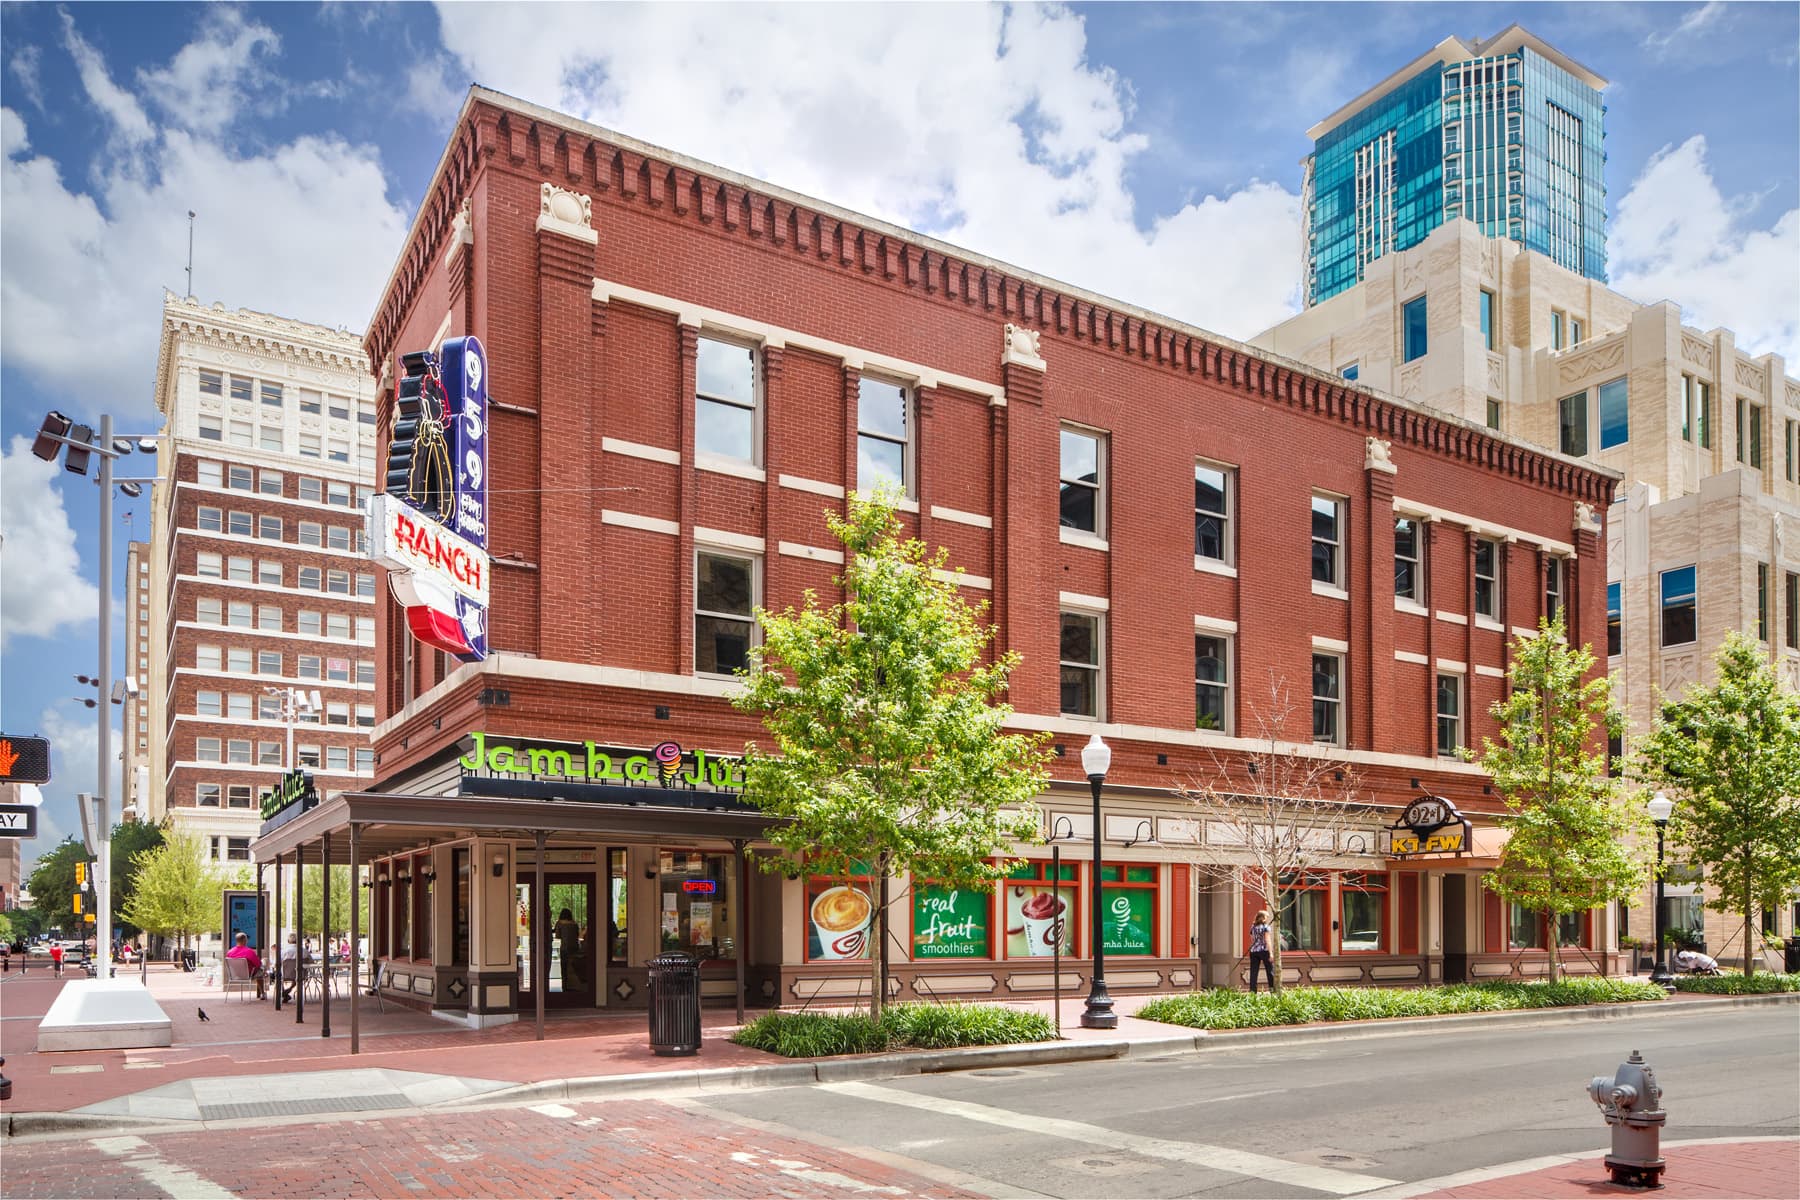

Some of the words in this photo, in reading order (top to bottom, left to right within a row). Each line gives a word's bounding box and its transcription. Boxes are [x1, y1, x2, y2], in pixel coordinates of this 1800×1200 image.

[395, 513, 480, 590] RANCH
[459, 732, 656, 781] Jamba
[683, 882, 713, 891] OPEN
[922, 890, 958, 914] real
[921, 913, 976, 944] fruit
[922, 941, 974, 953] smoothies
[1103, 940, 1122, 948] mba
[1123, 938, 1144, 948] Juice
